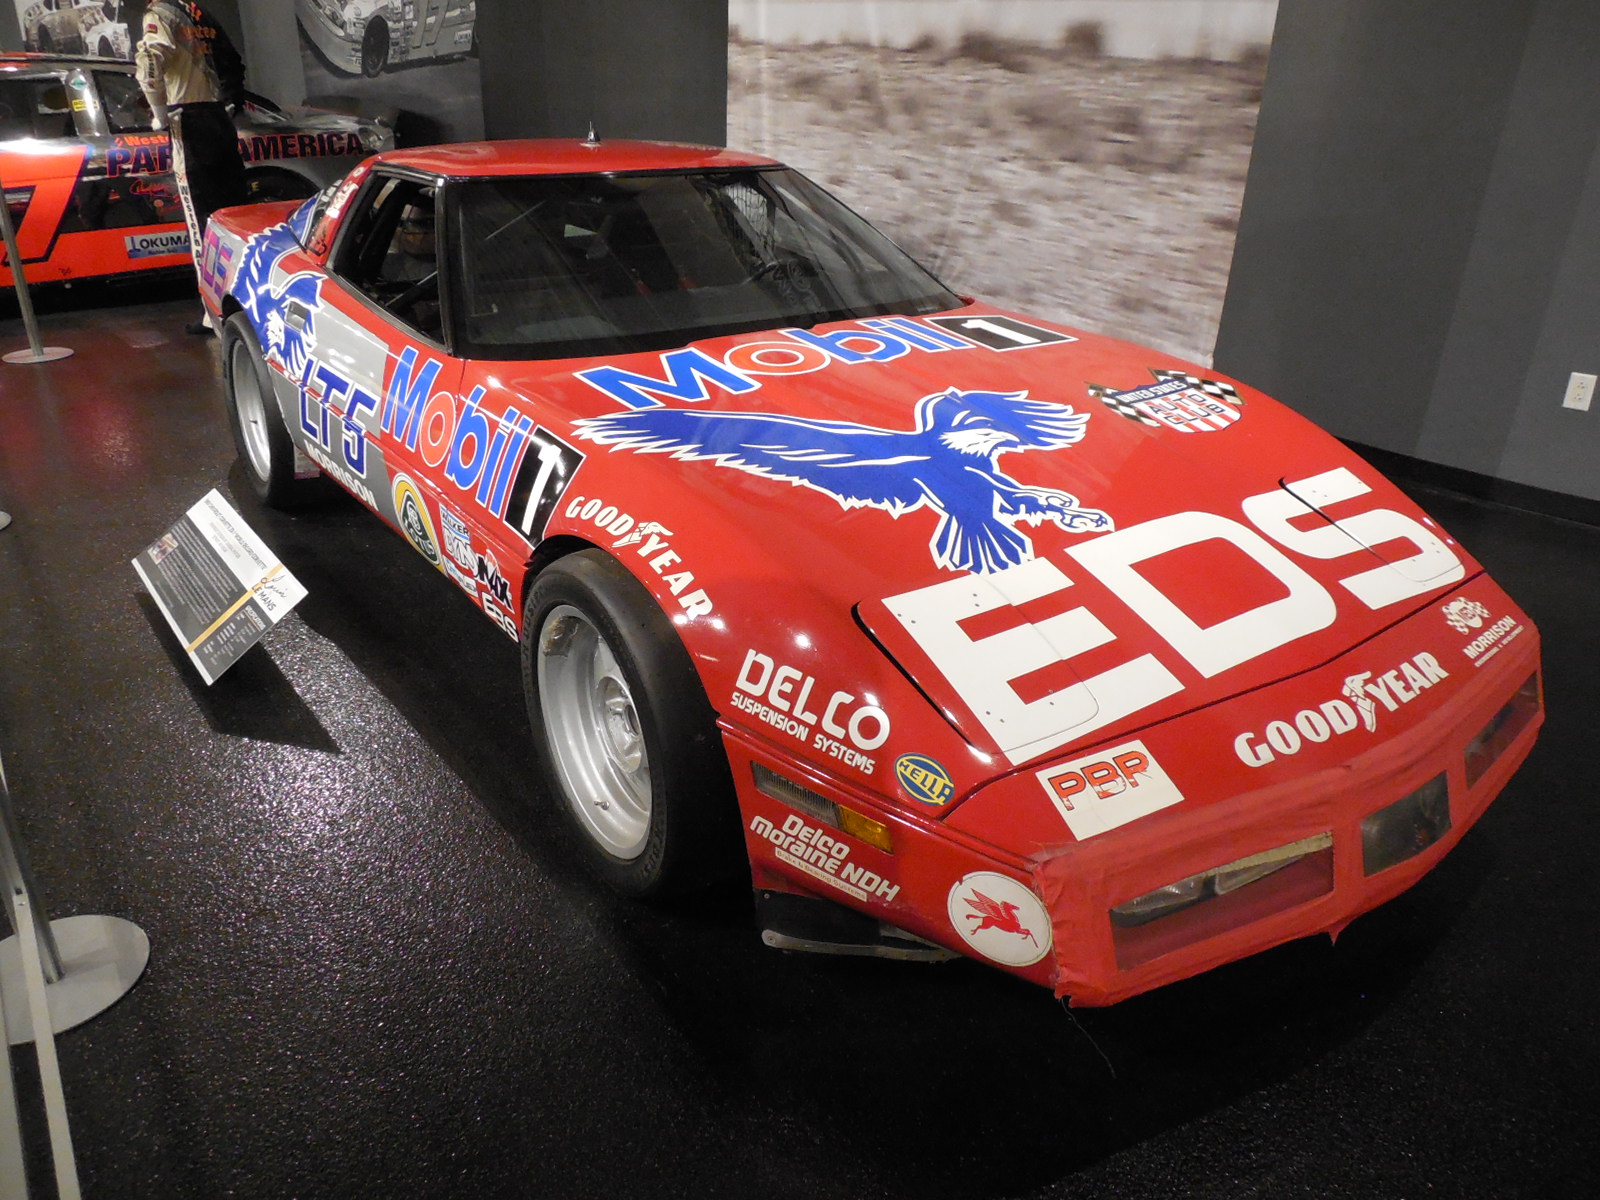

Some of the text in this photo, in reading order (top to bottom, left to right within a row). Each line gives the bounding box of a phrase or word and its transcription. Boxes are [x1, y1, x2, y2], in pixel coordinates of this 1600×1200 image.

[572, 316, 1042, 411] Mobil 1
[1150, 380, 1188, 396] STATES
[298, 355, 381, 479] LT5
[380, 345, 562, 536] Mobil 1
[1148, 393, 1207, 415] AUTO
[1164, 403, 1227, 426] CLUB
[304, 438, 379, 512] MORRISON
[565, 496, 713, 620] GOODYEAR
[882, 467, 1465, 765] EDS
[1462, 615, 1517, 660] MORRISON
[730, 692, 876, 775] SUSPENSION SYSTEMS
[735, 648, 890, 750] DELCO
[1234, 652, 1450, 768] GOODYEAR
[898, 759, 955, 806] HELLA
[1048, 750, 1151, 811] PBR
[840, 862, 900, 902] NDH
